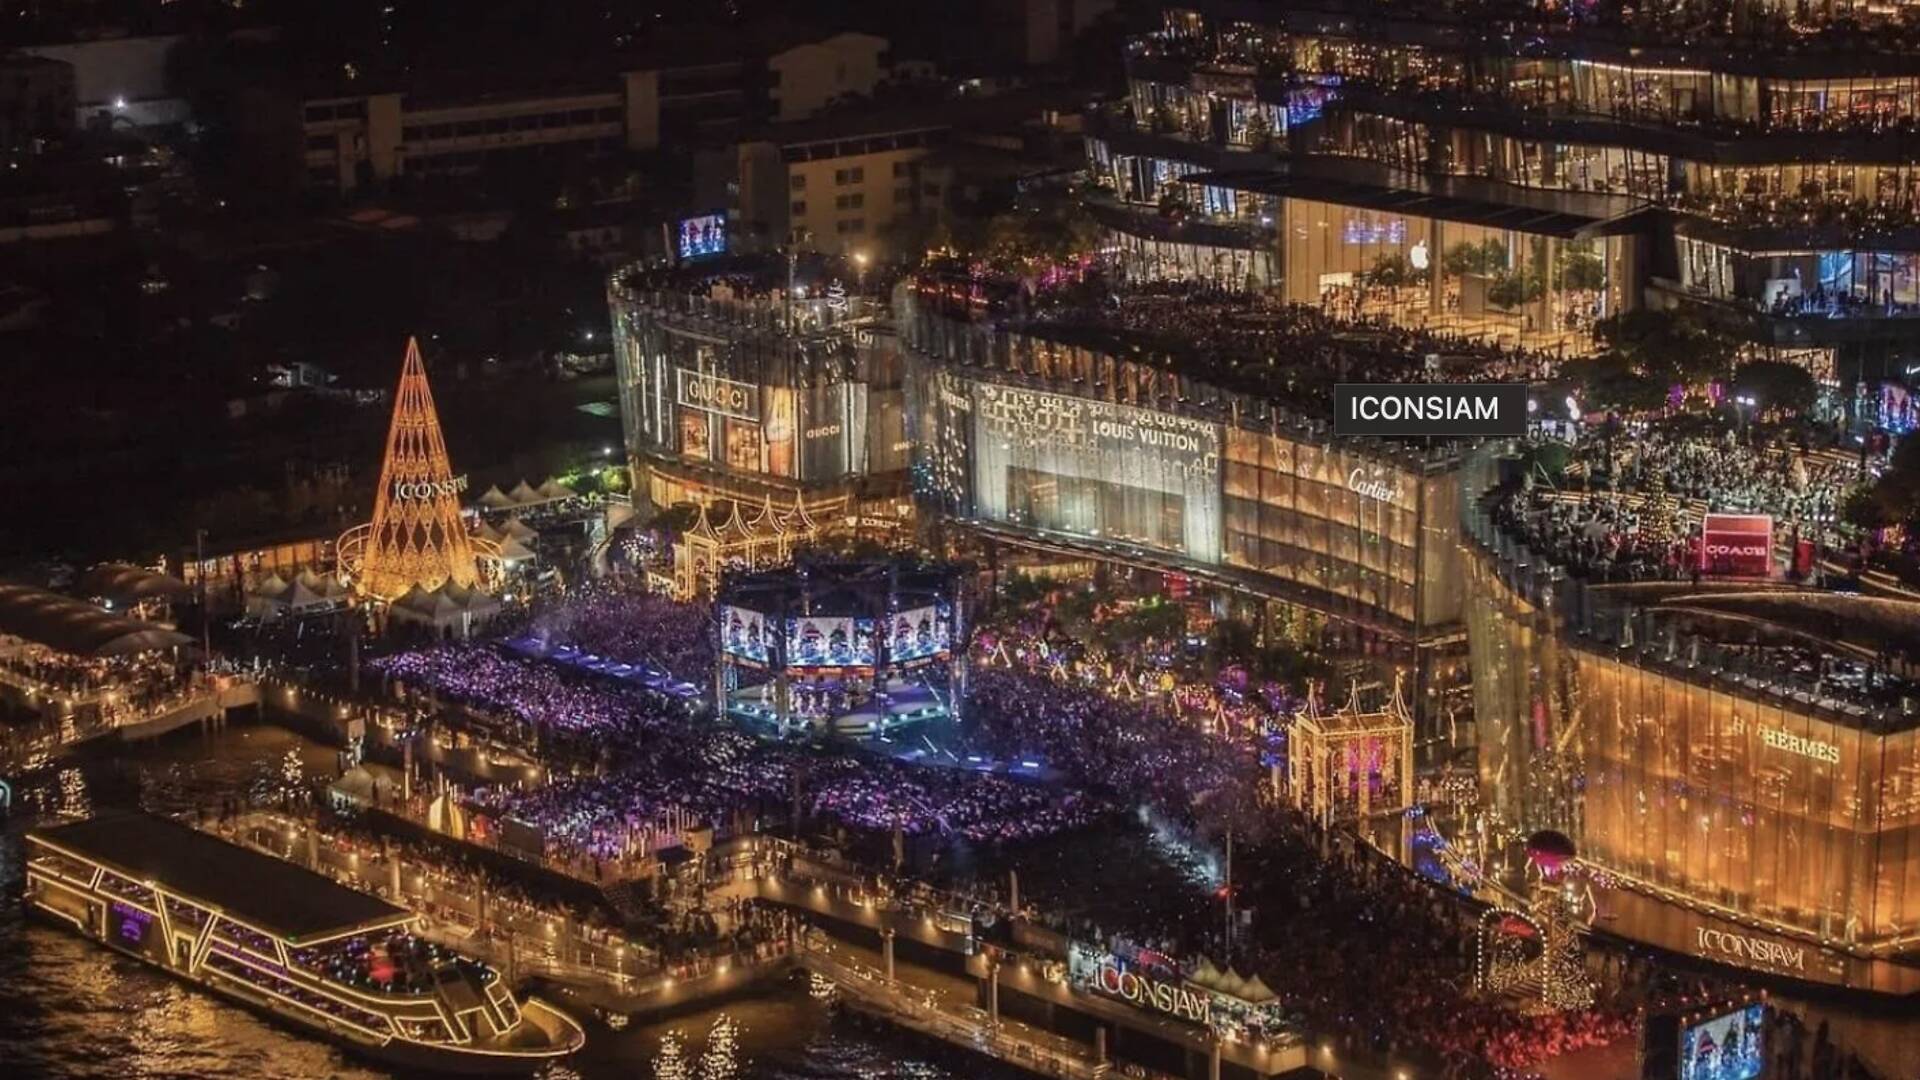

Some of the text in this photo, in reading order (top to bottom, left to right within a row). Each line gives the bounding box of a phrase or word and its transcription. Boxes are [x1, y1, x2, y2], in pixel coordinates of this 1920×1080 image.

[689, 380, 749, 410] GUCCI
[1093, 420, 1199, 452] LOUIS VUITTON
[1348, 467, 1395, 501] Cartier
[1706, 545, 1766, 556] COACH
[1697, 926, 1805, 971] ICONSIAM
[1090, 964, 1211, 1025] ICONSIAM
